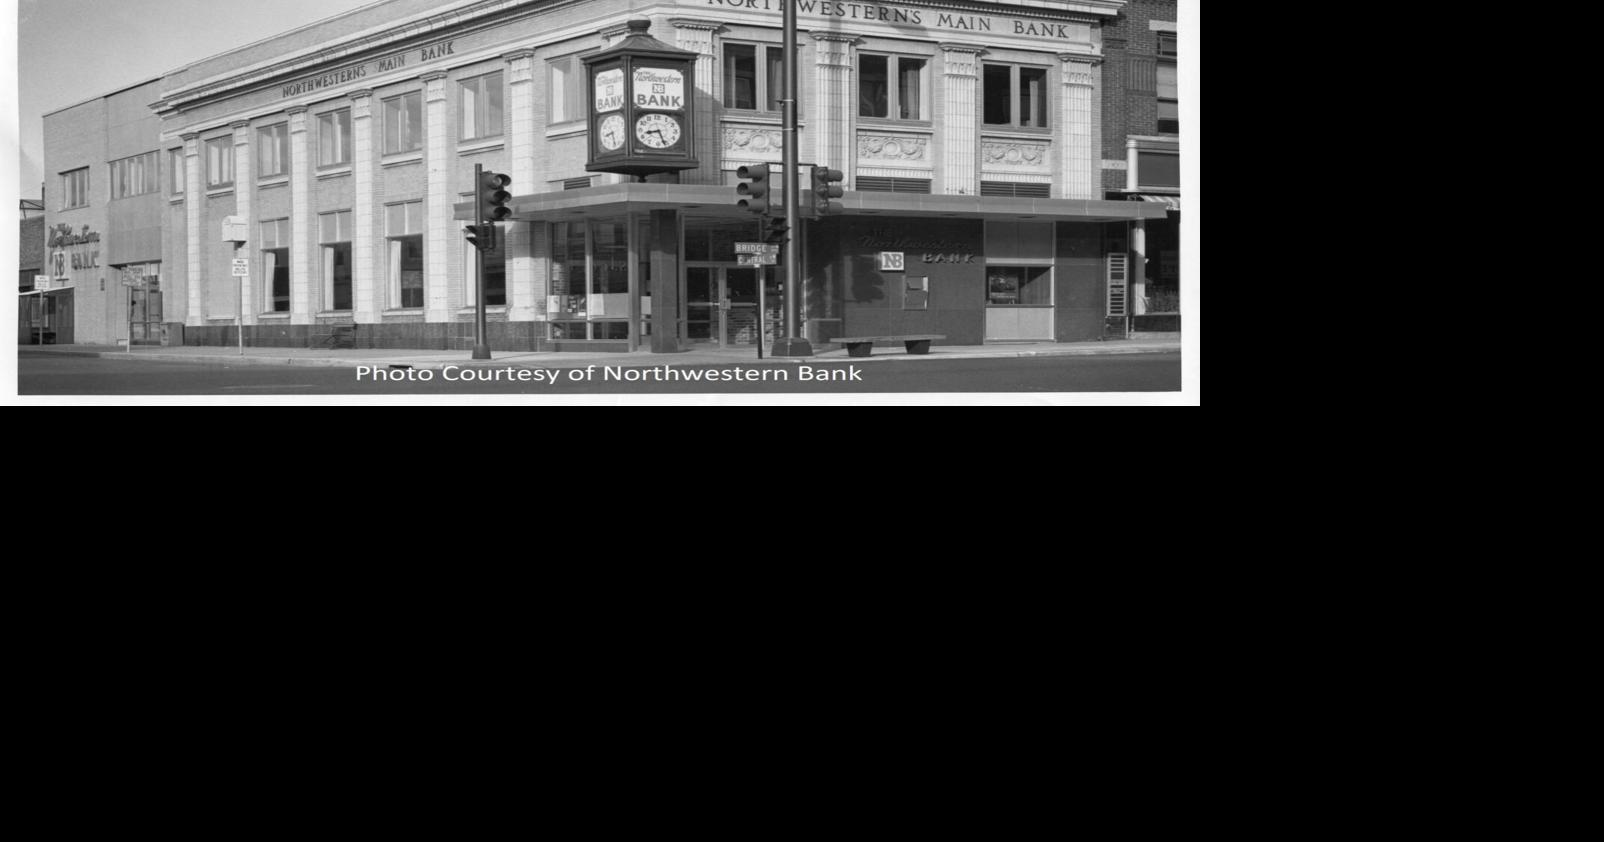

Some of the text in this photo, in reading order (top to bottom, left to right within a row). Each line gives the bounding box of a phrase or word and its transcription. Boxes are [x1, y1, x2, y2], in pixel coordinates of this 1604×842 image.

[707, 0, 1069, 38] RTWESTERN'S MAIN BANK
[378, 55, 406, 72] MAIN
[421, 41, 454, 61] BANK
[597, 95, 623, 110] BANK
[637, 94, 681, 107] BANK
[736, 244, 767, 253] BRIDGE
[738, 255, 766, 264] CNTRAL
[883, 253, 903, 268] NB
[922, 253, 975, 263] BANK
